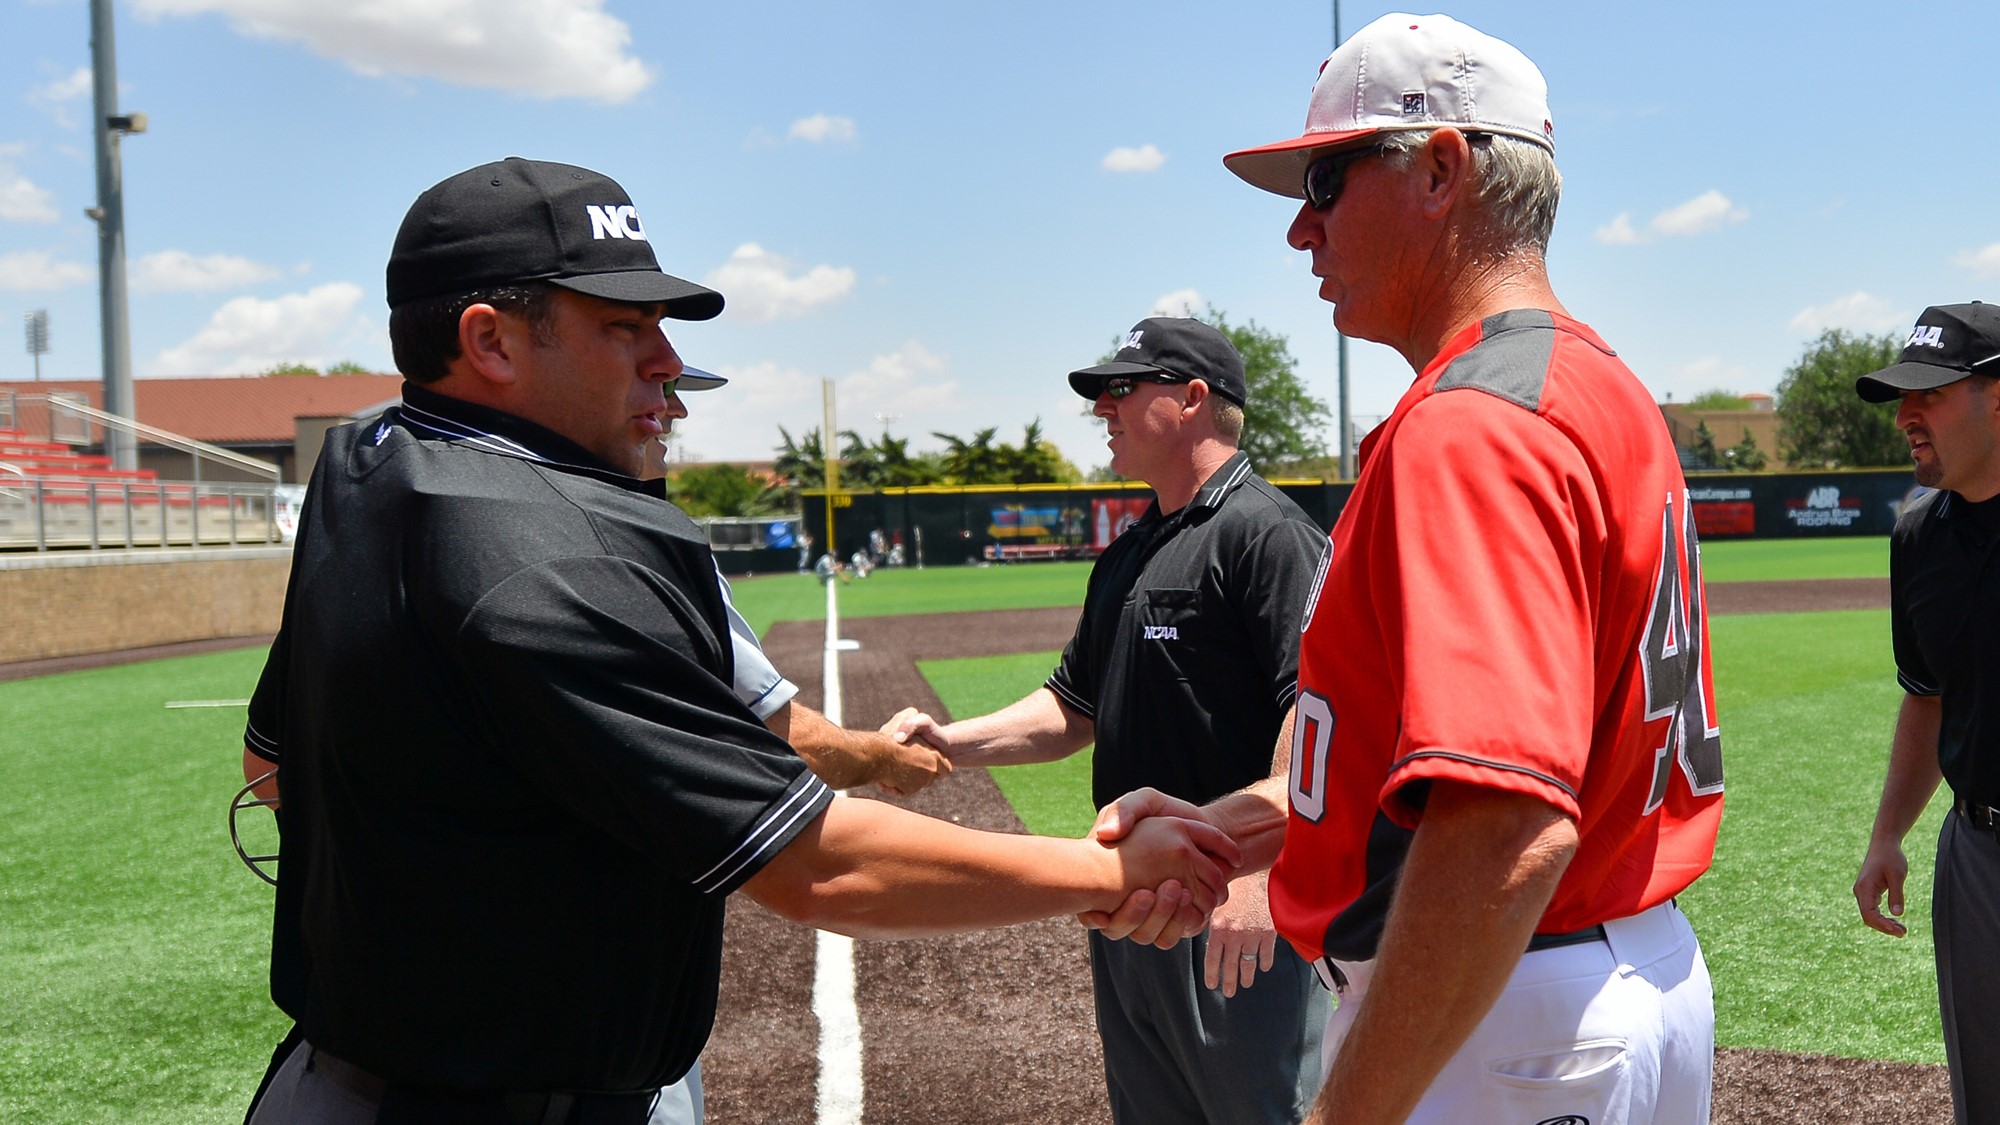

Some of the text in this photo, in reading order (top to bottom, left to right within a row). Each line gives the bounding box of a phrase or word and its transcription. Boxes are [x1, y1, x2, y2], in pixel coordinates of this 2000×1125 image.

[587, 205, 648, 240] NC
[1807, 486, 1841, 508] ABR
[1797, 517, 1852, 526] ROOFING
[1144, 626, 1178, 640] NCAA
